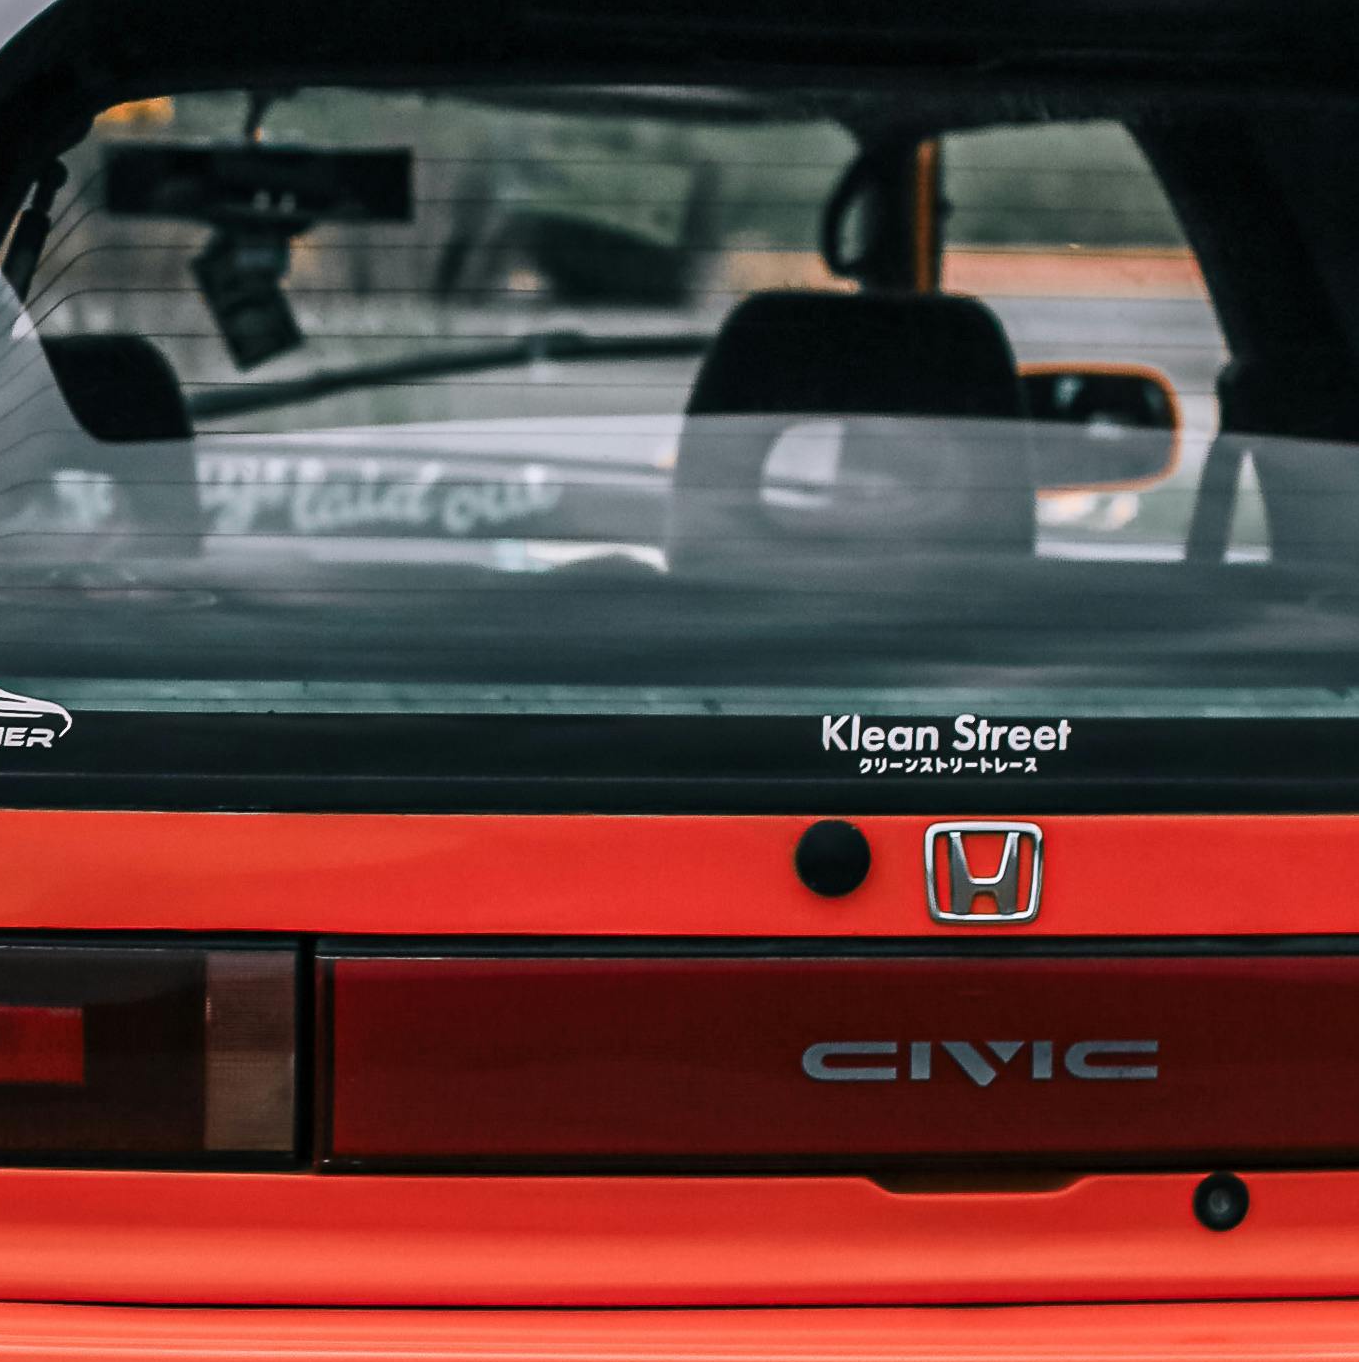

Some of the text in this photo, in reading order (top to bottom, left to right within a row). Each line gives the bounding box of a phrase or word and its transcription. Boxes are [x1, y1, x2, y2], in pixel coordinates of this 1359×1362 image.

[821, 713, 1072, 752] Klean Street
[802, 1041, 1158, 1087] CIVIC
